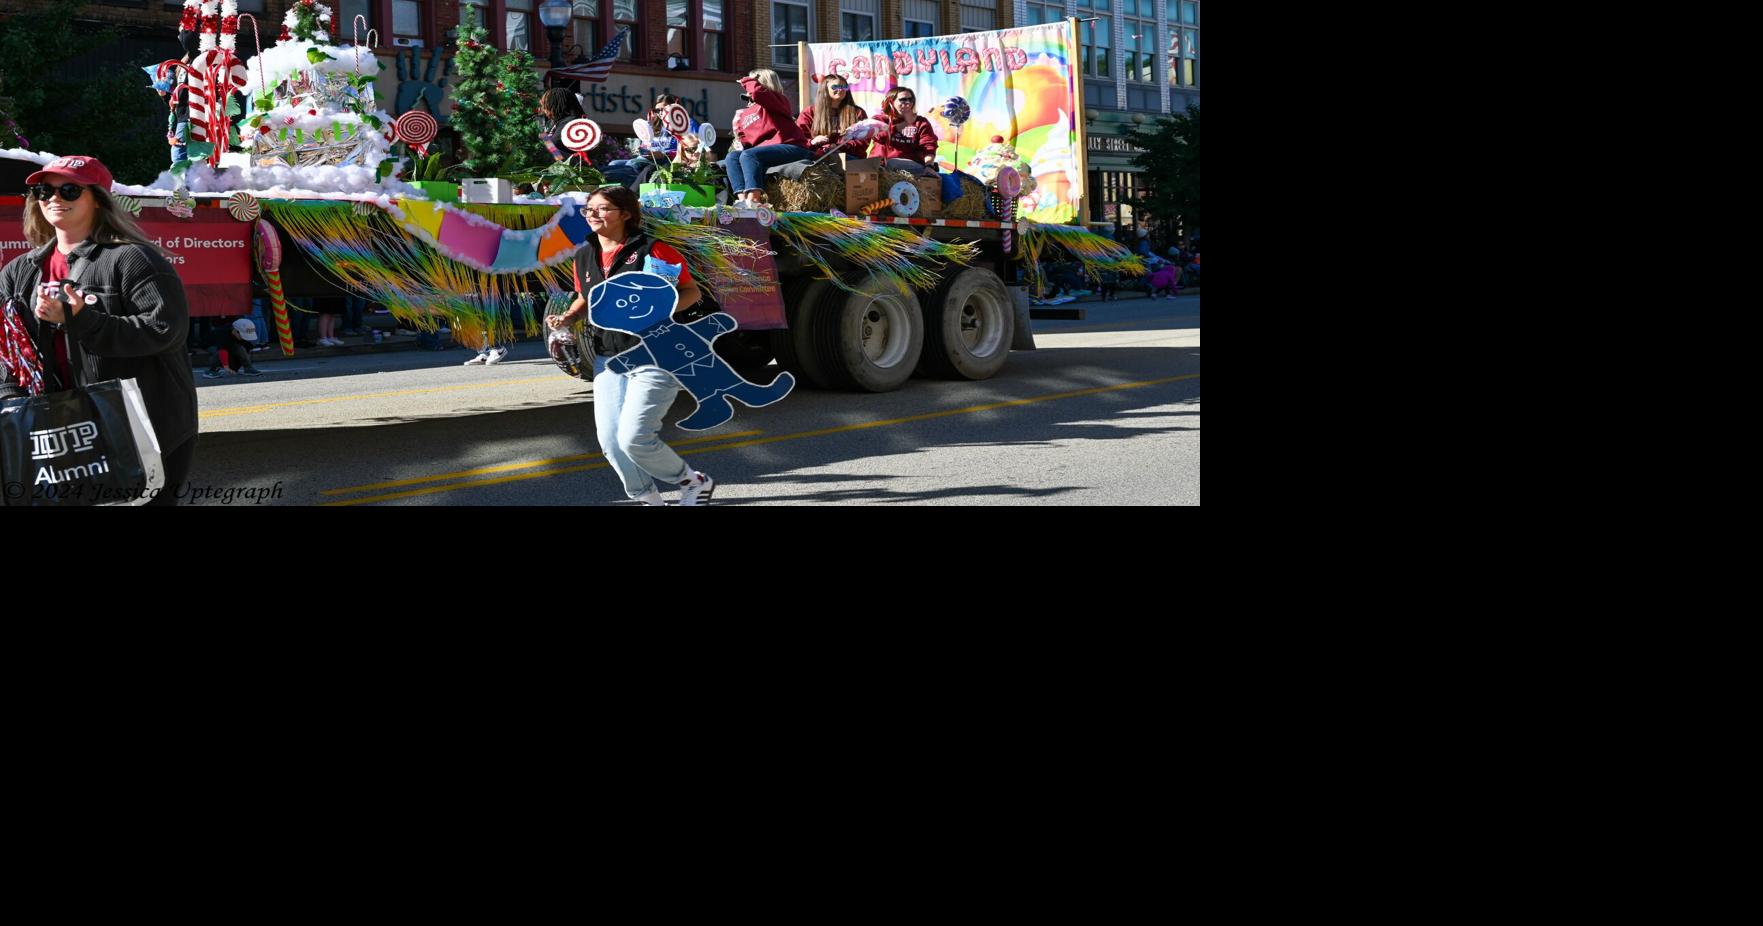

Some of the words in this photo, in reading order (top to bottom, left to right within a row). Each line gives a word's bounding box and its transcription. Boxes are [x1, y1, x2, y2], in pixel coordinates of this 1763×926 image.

[829, 47, 1028, 80] CANDYLAND
[650, 86, 709, 123] Hnd
[0, 240, 36, 249] umn
[166, 237, 180, 248] of
[184, 237, 245, 248] Directors
[162, 253, 185, 264] ors
[29, 420, 99, 460] IUP
[34, 455, 110, 486] Alumni
